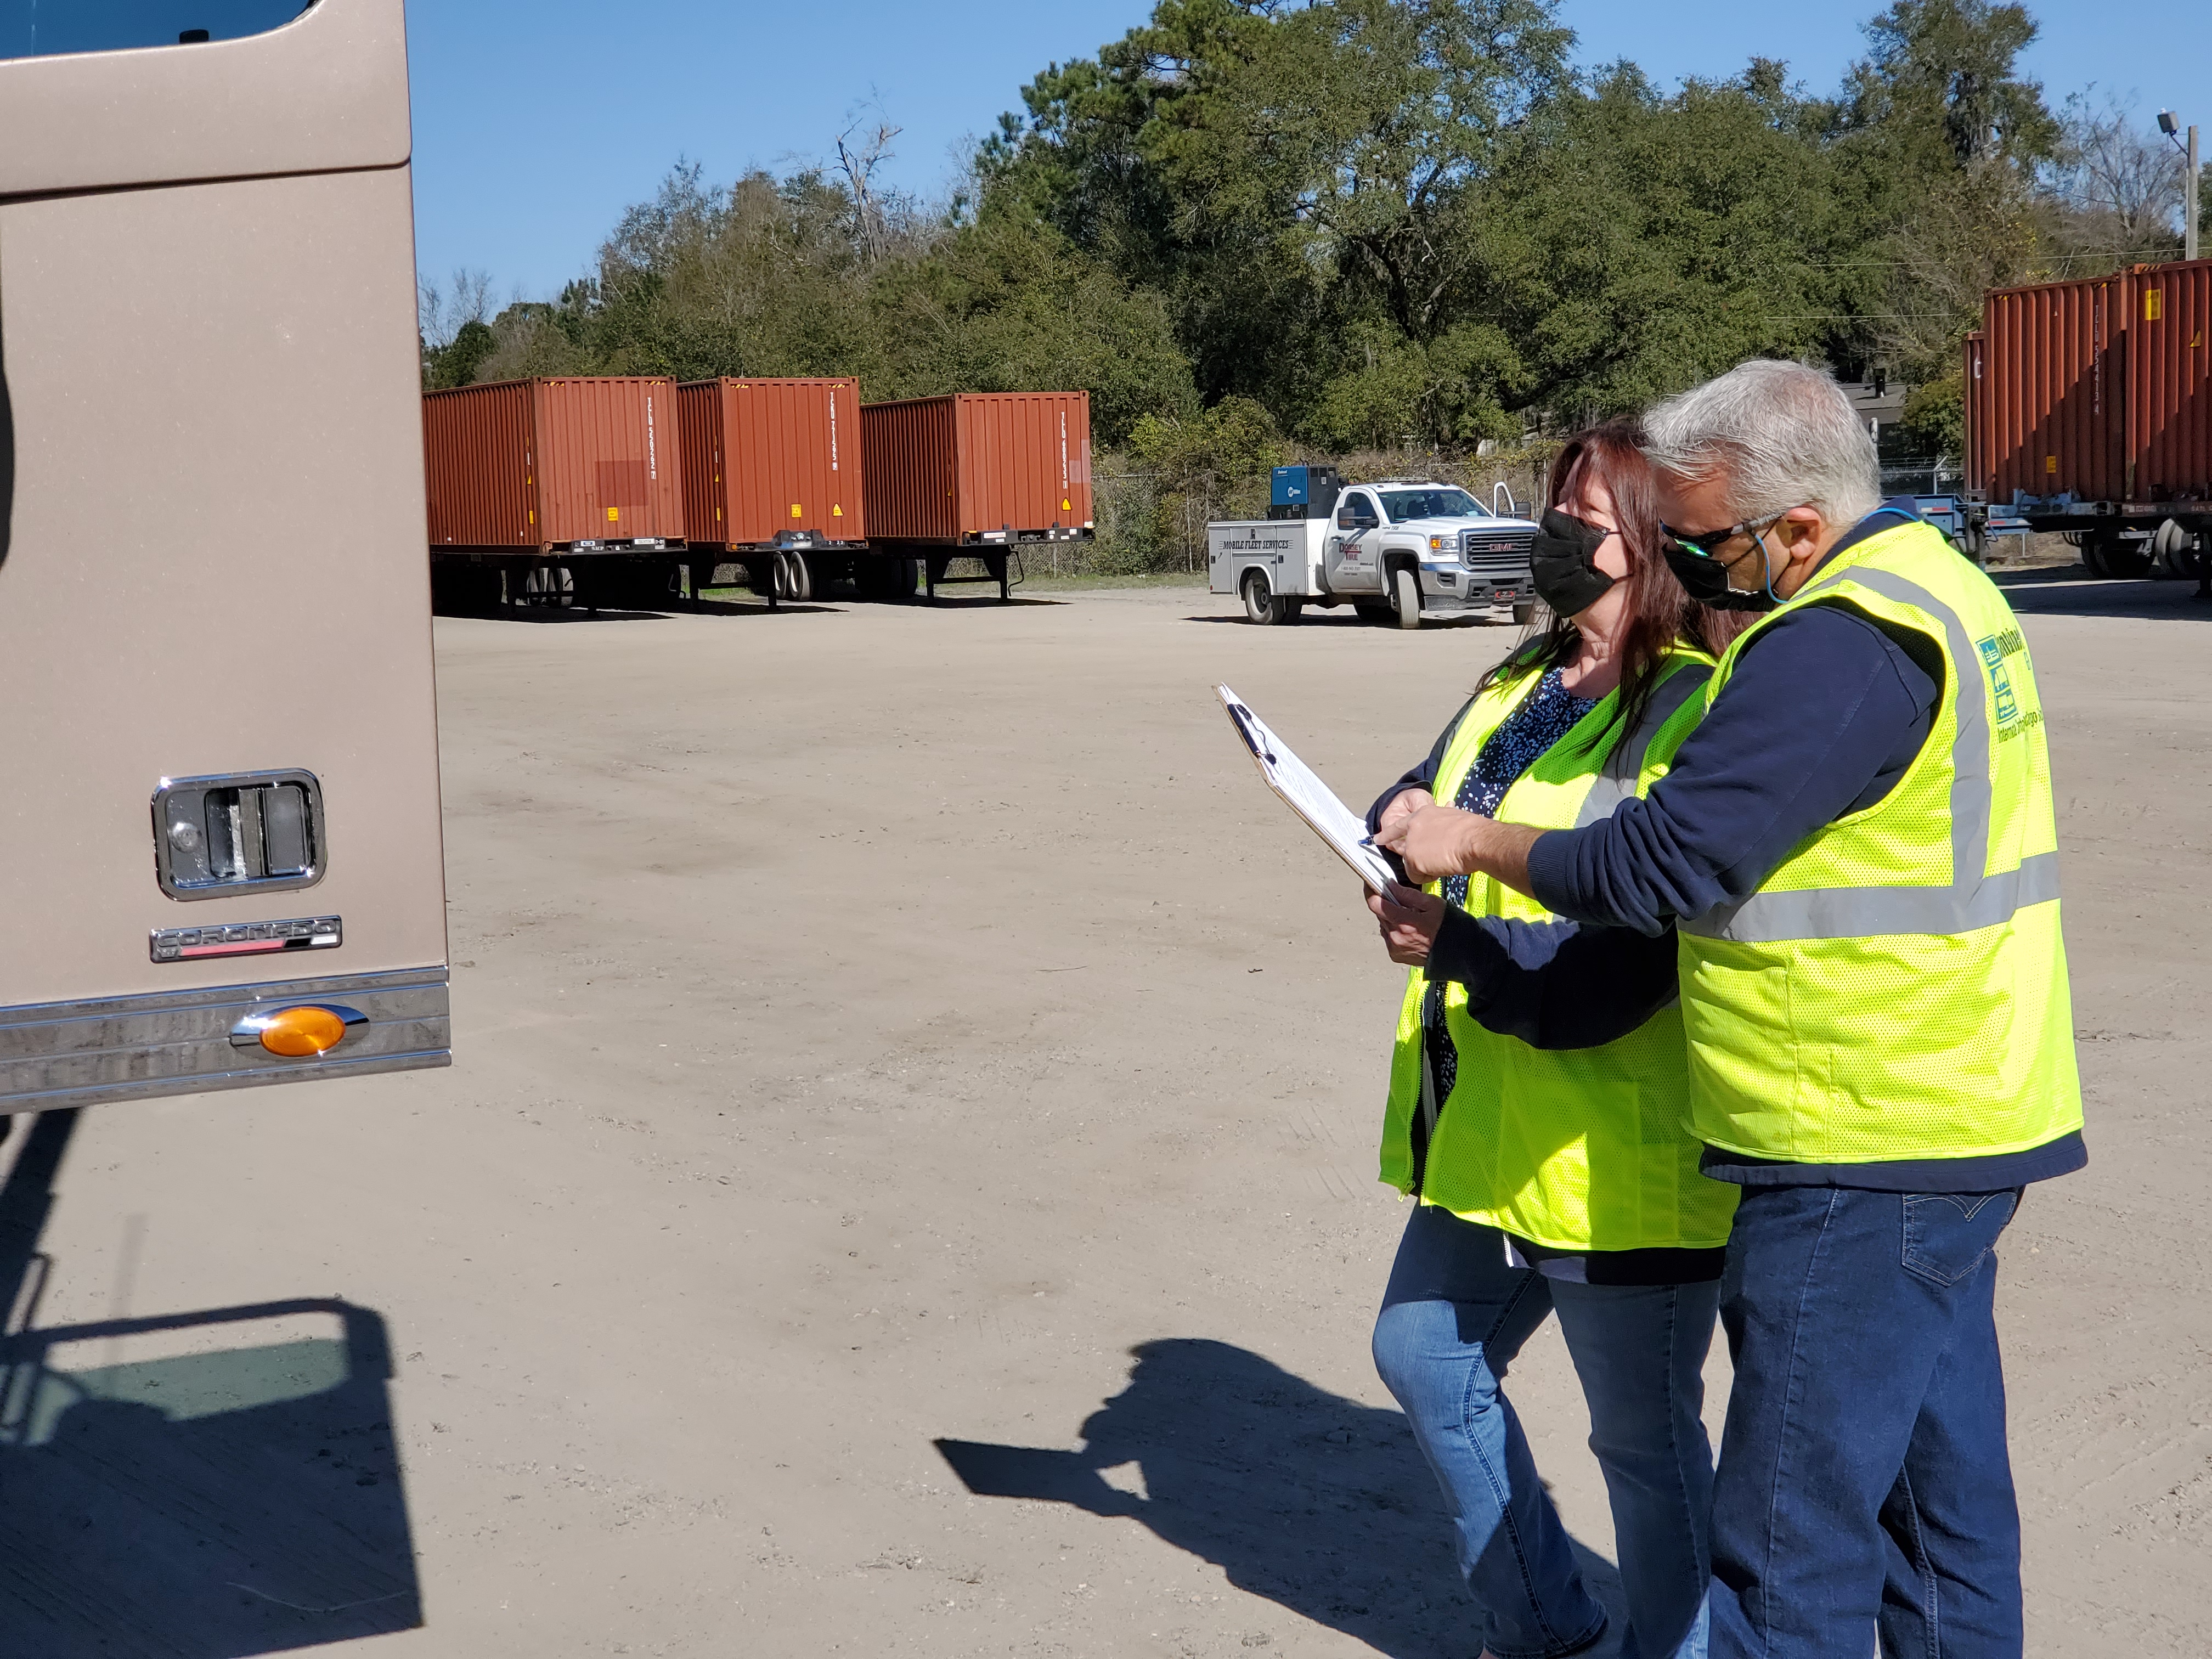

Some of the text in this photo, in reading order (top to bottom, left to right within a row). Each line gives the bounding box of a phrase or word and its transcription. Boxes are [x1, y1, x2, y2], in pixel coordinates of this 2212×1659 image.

[651, 471, 656, 479] 7
[1223, 540, 1288, 549] MOBILE FLEET SERVICES
[1339, 543, 1362, 553] DORSEY
[1489, 543, 1519, 552] GMC
[1345, 551, 1359, 561] TIRE
[157, 919, 337, 948] CORONADO
